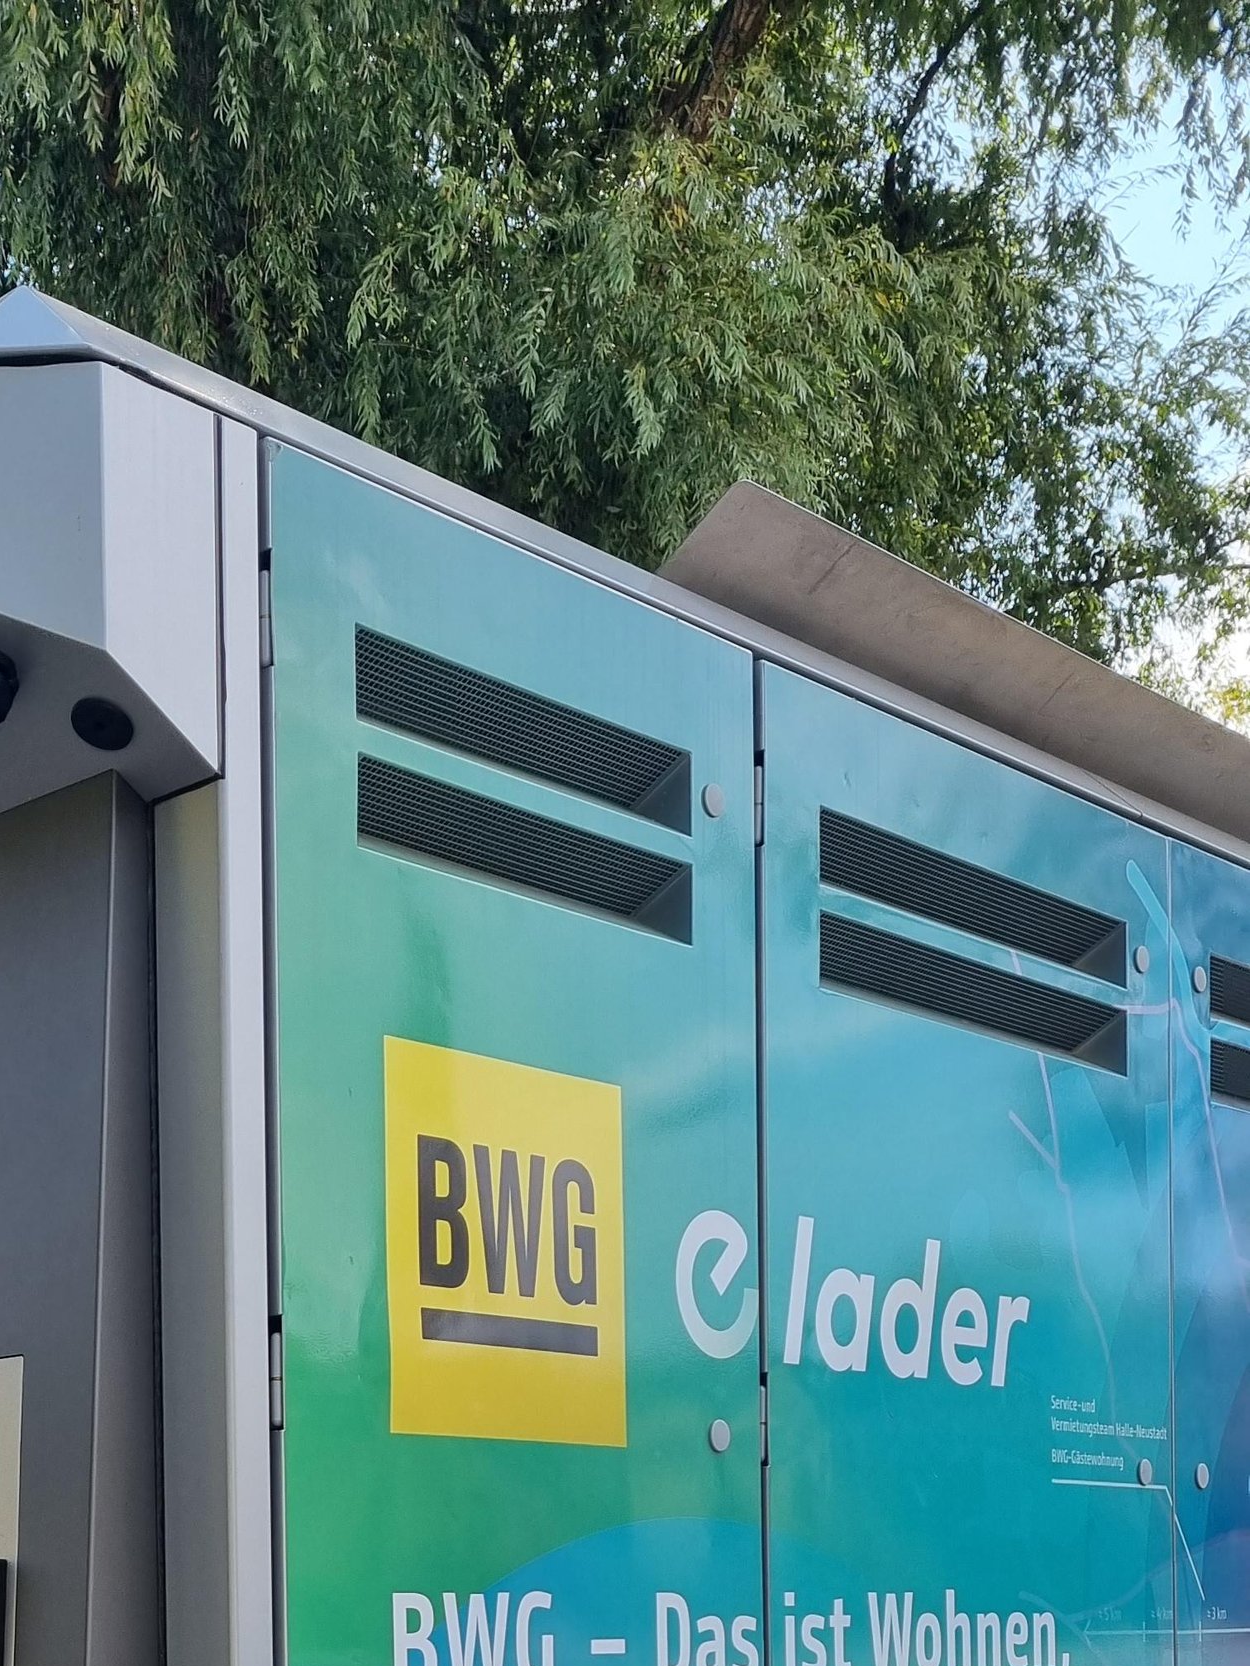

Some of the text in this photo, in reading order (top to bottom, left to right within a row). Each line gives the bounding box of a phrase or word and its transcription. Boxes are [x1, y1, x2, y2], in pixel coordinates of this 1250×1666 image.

[417, 1133, 599, 1306] BWG
[783, 1215, 1031, 1387] lader
[1050, 1415, 1168, 1440] Vermietungsteam Halle-Neustadt
[1051, 1448, 1124, 1471] BWG-Gästewohnung
